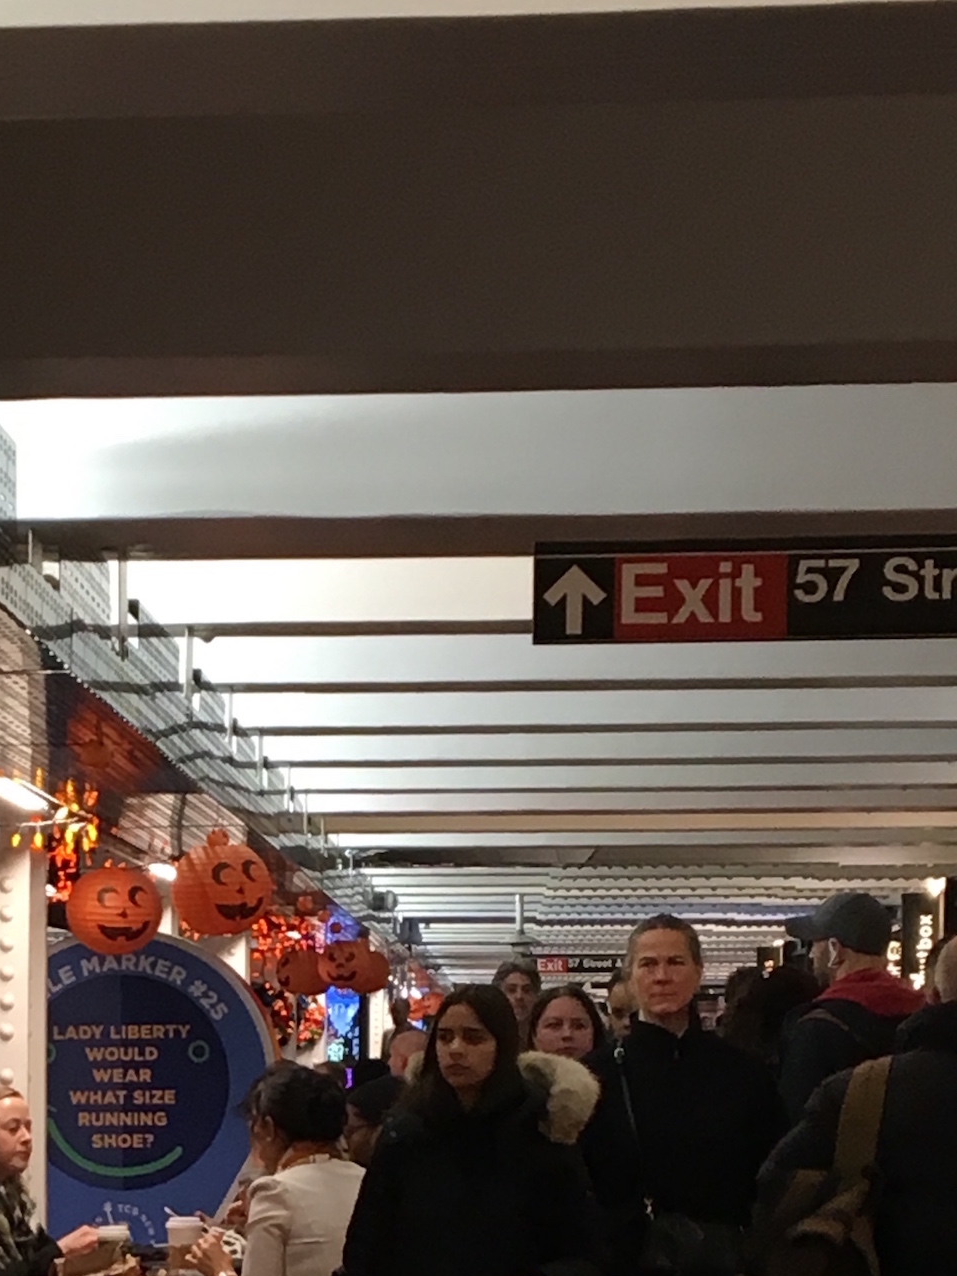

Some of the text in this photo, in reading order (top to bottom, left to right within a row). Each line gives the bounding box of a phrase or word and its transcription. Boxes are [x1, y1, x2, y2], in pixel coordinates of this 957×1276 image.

[620, 556, 957, 624] Exit 57 Str
[537, 959, 563, 971] Exit
[48, 953, 230, 1022] LE MARKER #25
[53, 1024, 191, 1040] LADY LIBERTY
[85, 1046, 159, 1061] WOULD
[92, 1068, 152, 1083] WEAR
[69, 1090, 177, 1105] WHAT SIZE
[78, 1111, 168, 1127] RUNNING
[91, 1133, 155, 1149] SHOE?
